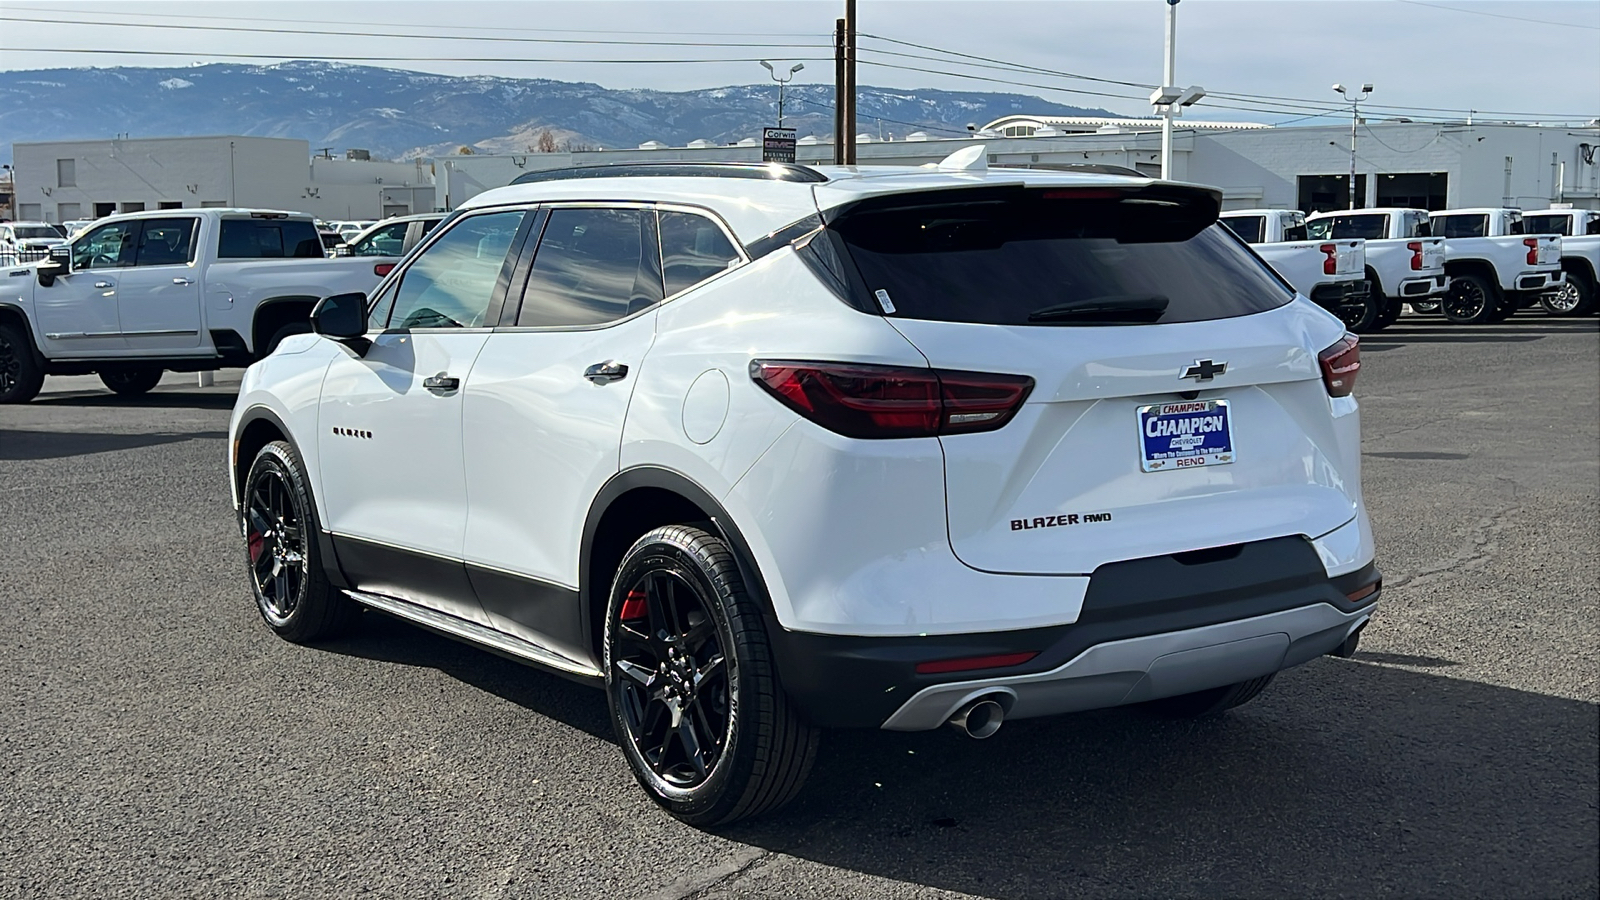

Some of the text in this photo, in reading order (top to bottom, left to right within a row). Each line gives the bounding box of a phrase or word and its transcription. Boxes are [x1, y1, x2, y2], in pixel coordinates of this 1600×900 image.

[767, 130, 796, 139] Corwin
[1163, 402, 1206, 414] CHAMPION
[1146, 415, 1223, 438] CHAMPION
[333, 426, 373, 440] BLAZER
[1171, 437, 1203, 446] CHEVROLET
[1176, 457, 1205, 467] RENO
[1010, 513, 1112, 531] BLAZER AWD
